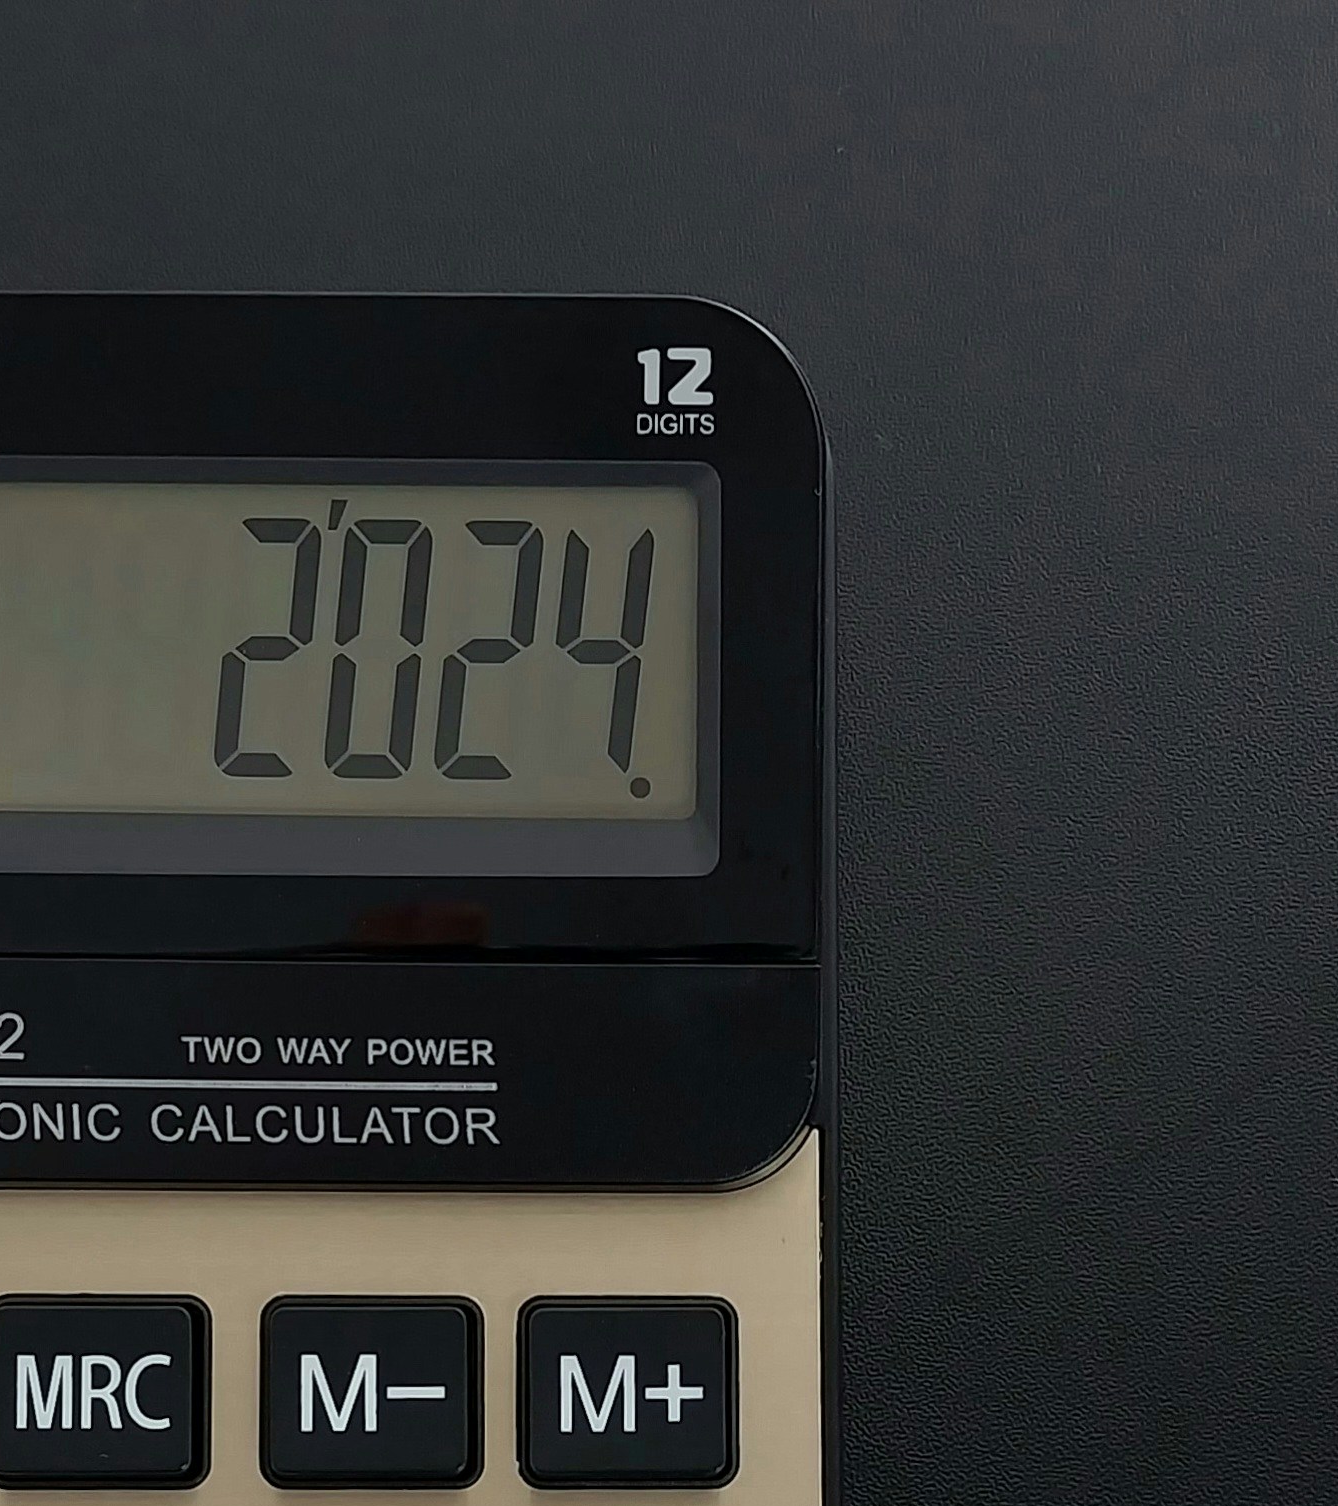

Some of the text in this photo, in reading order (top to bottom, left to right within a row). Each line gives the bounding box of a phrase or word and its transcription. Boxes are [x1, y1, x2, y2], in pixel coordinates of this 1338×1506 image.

[637, 347, 714, 406] 12
[636, 413, 715, 435] DIGITS
[180, 1036, 496, 1066] TWO WAY POWER
[150, 1104, 501, 1145] CALCULATOR
[15, 1353, 172, 1430] MRC
[560, 1354, 704, 1433] M+
